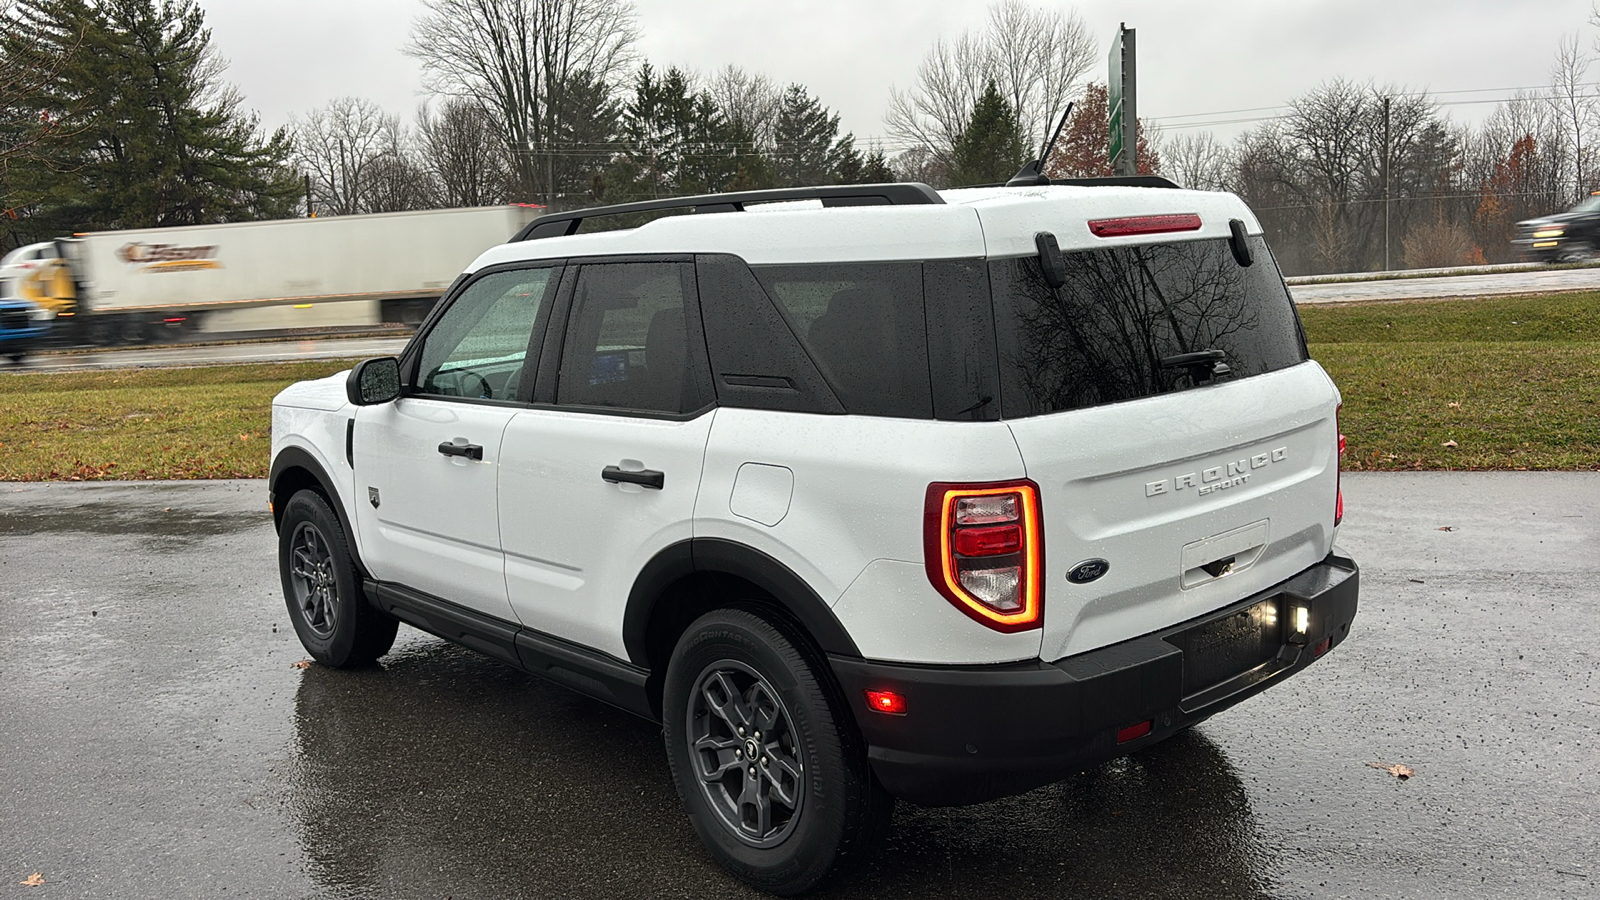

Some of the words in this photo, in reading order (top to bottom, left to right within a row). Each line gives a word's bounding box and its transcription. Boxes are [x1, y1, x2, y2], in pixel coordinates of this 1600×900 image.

[1145, 446, 1287, 497] BRONCO
[1198, 474, 1250, 496] SPORT
[1077, 564, 1102, 580] Ford
